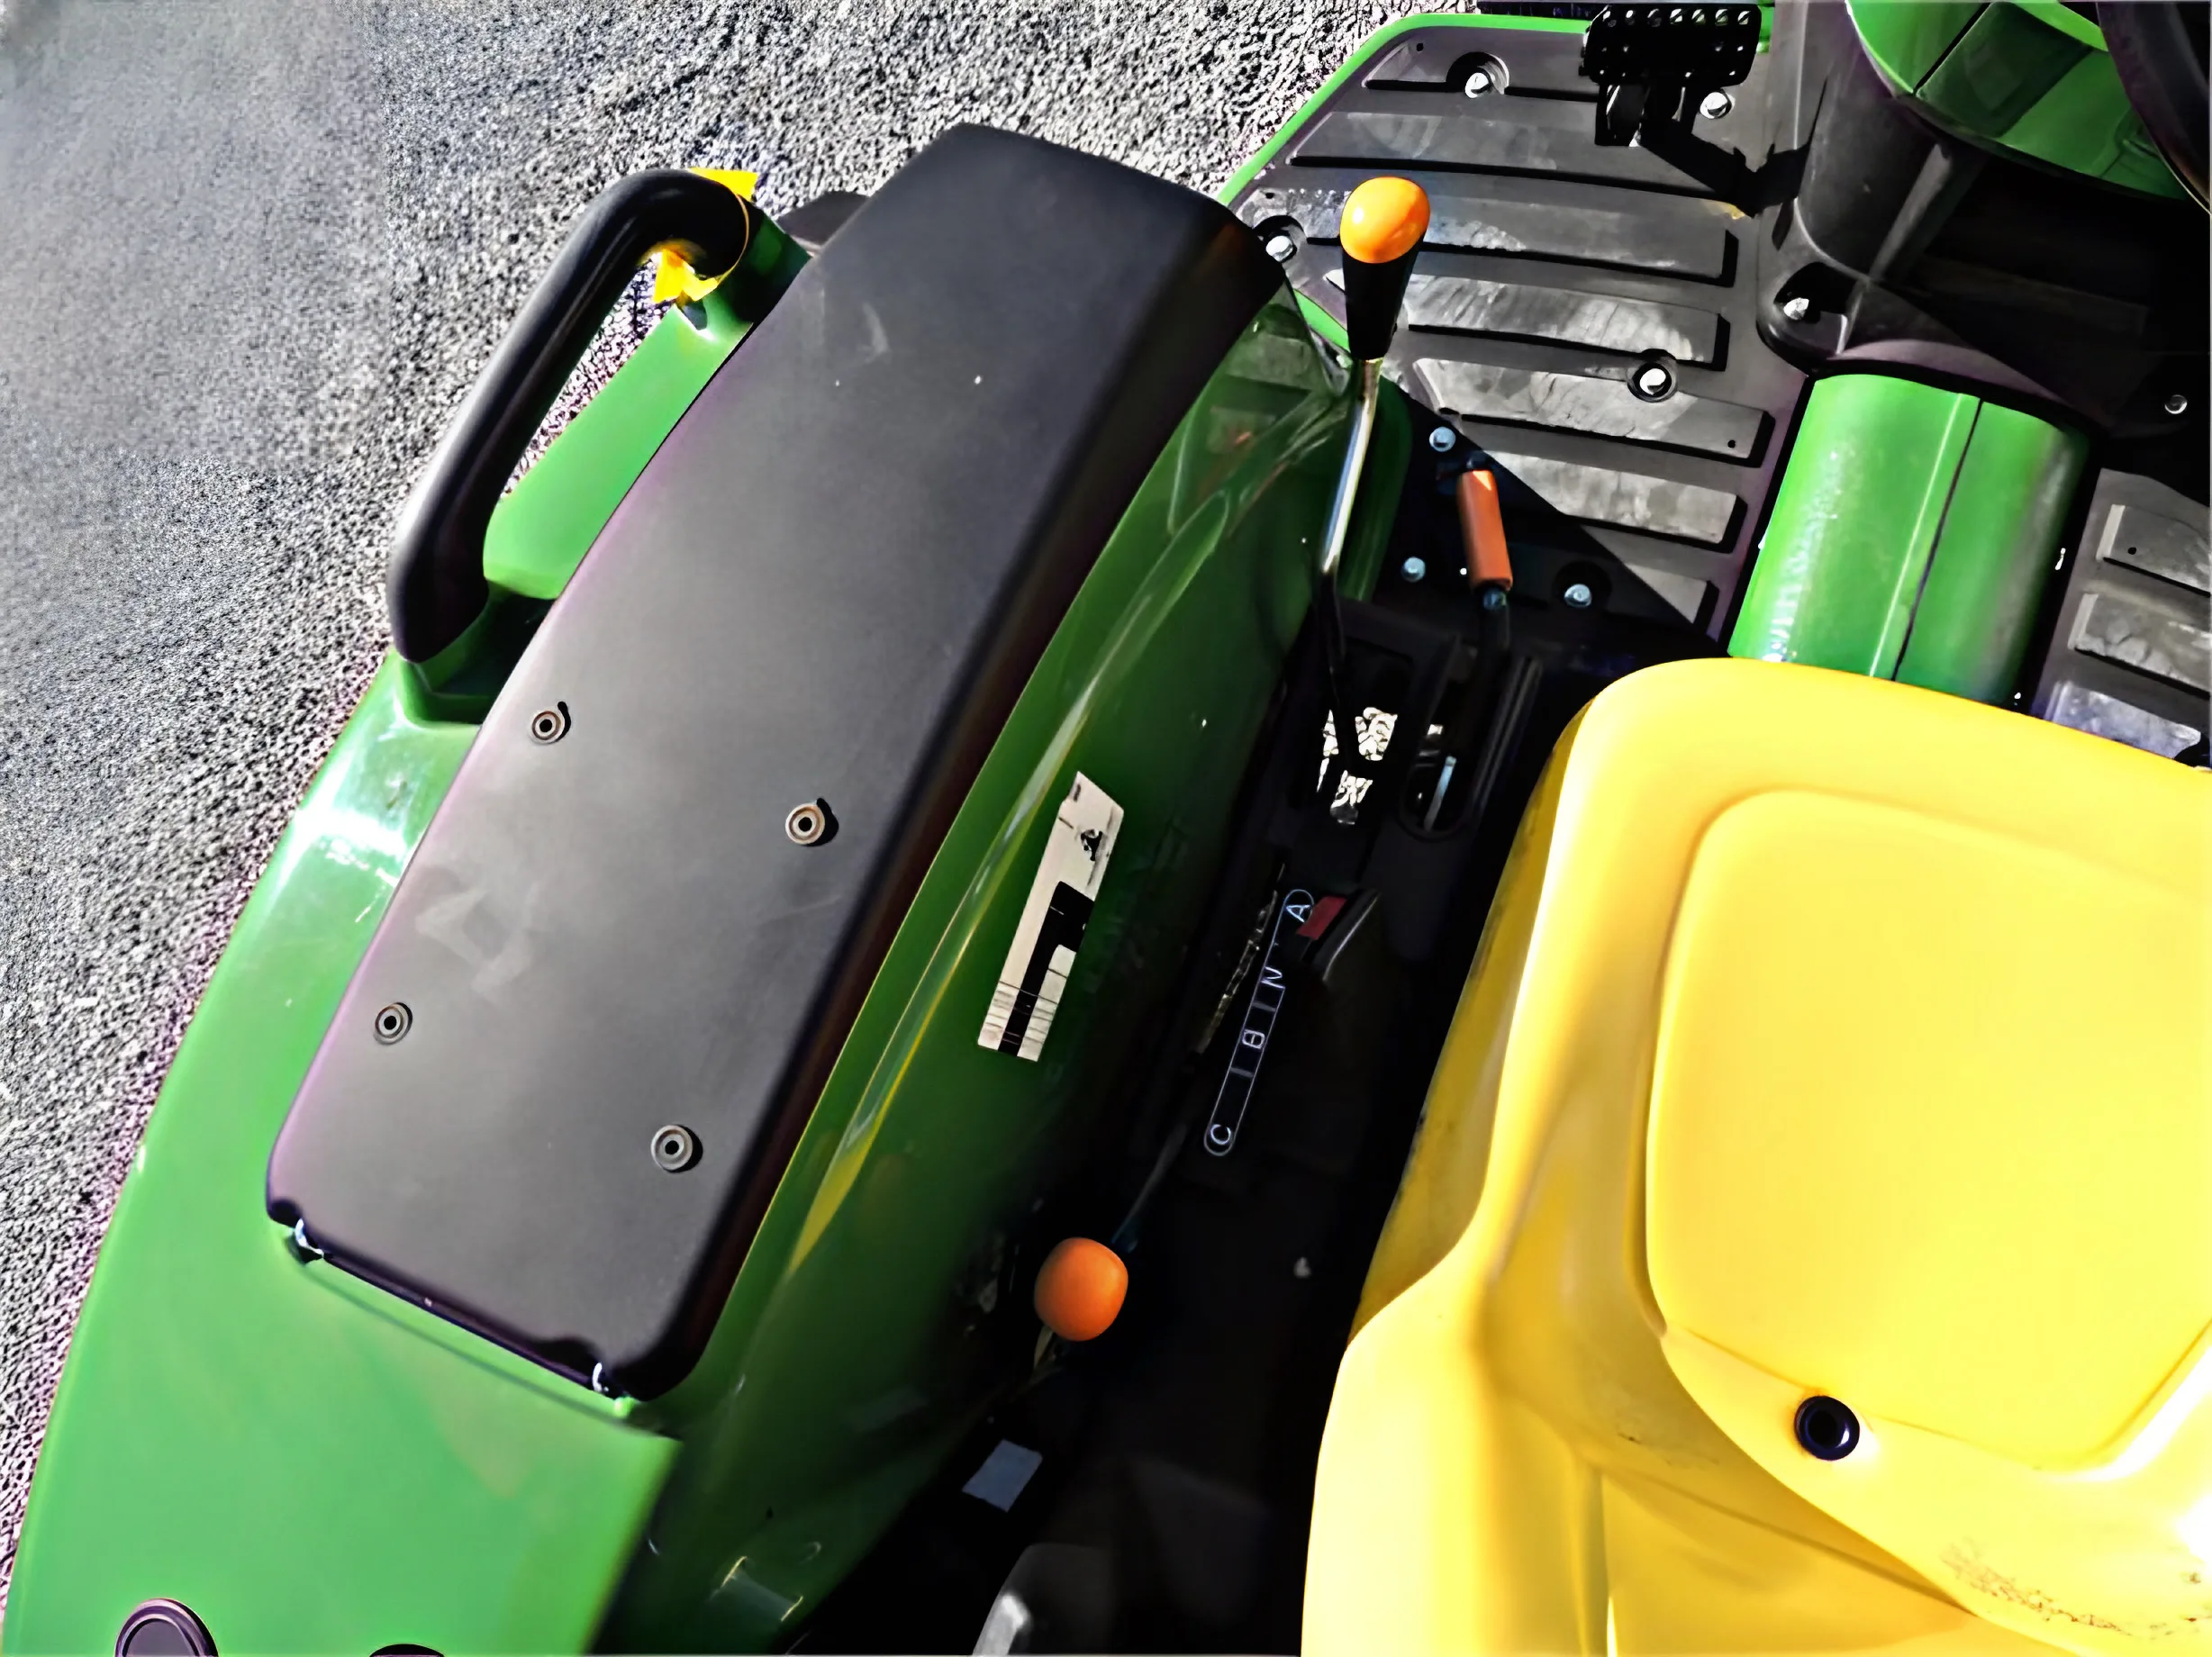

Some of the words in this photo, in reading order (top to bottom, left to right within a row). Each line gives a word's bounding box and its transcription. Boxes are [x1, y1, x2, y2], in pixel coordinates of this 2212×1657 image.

[1210, 1123, 1232, 1145] C
[1242, 1029, 1265, 1049] B
[1261, 965, 1286, 989] N
[1286, 904, 1311, 923] A
